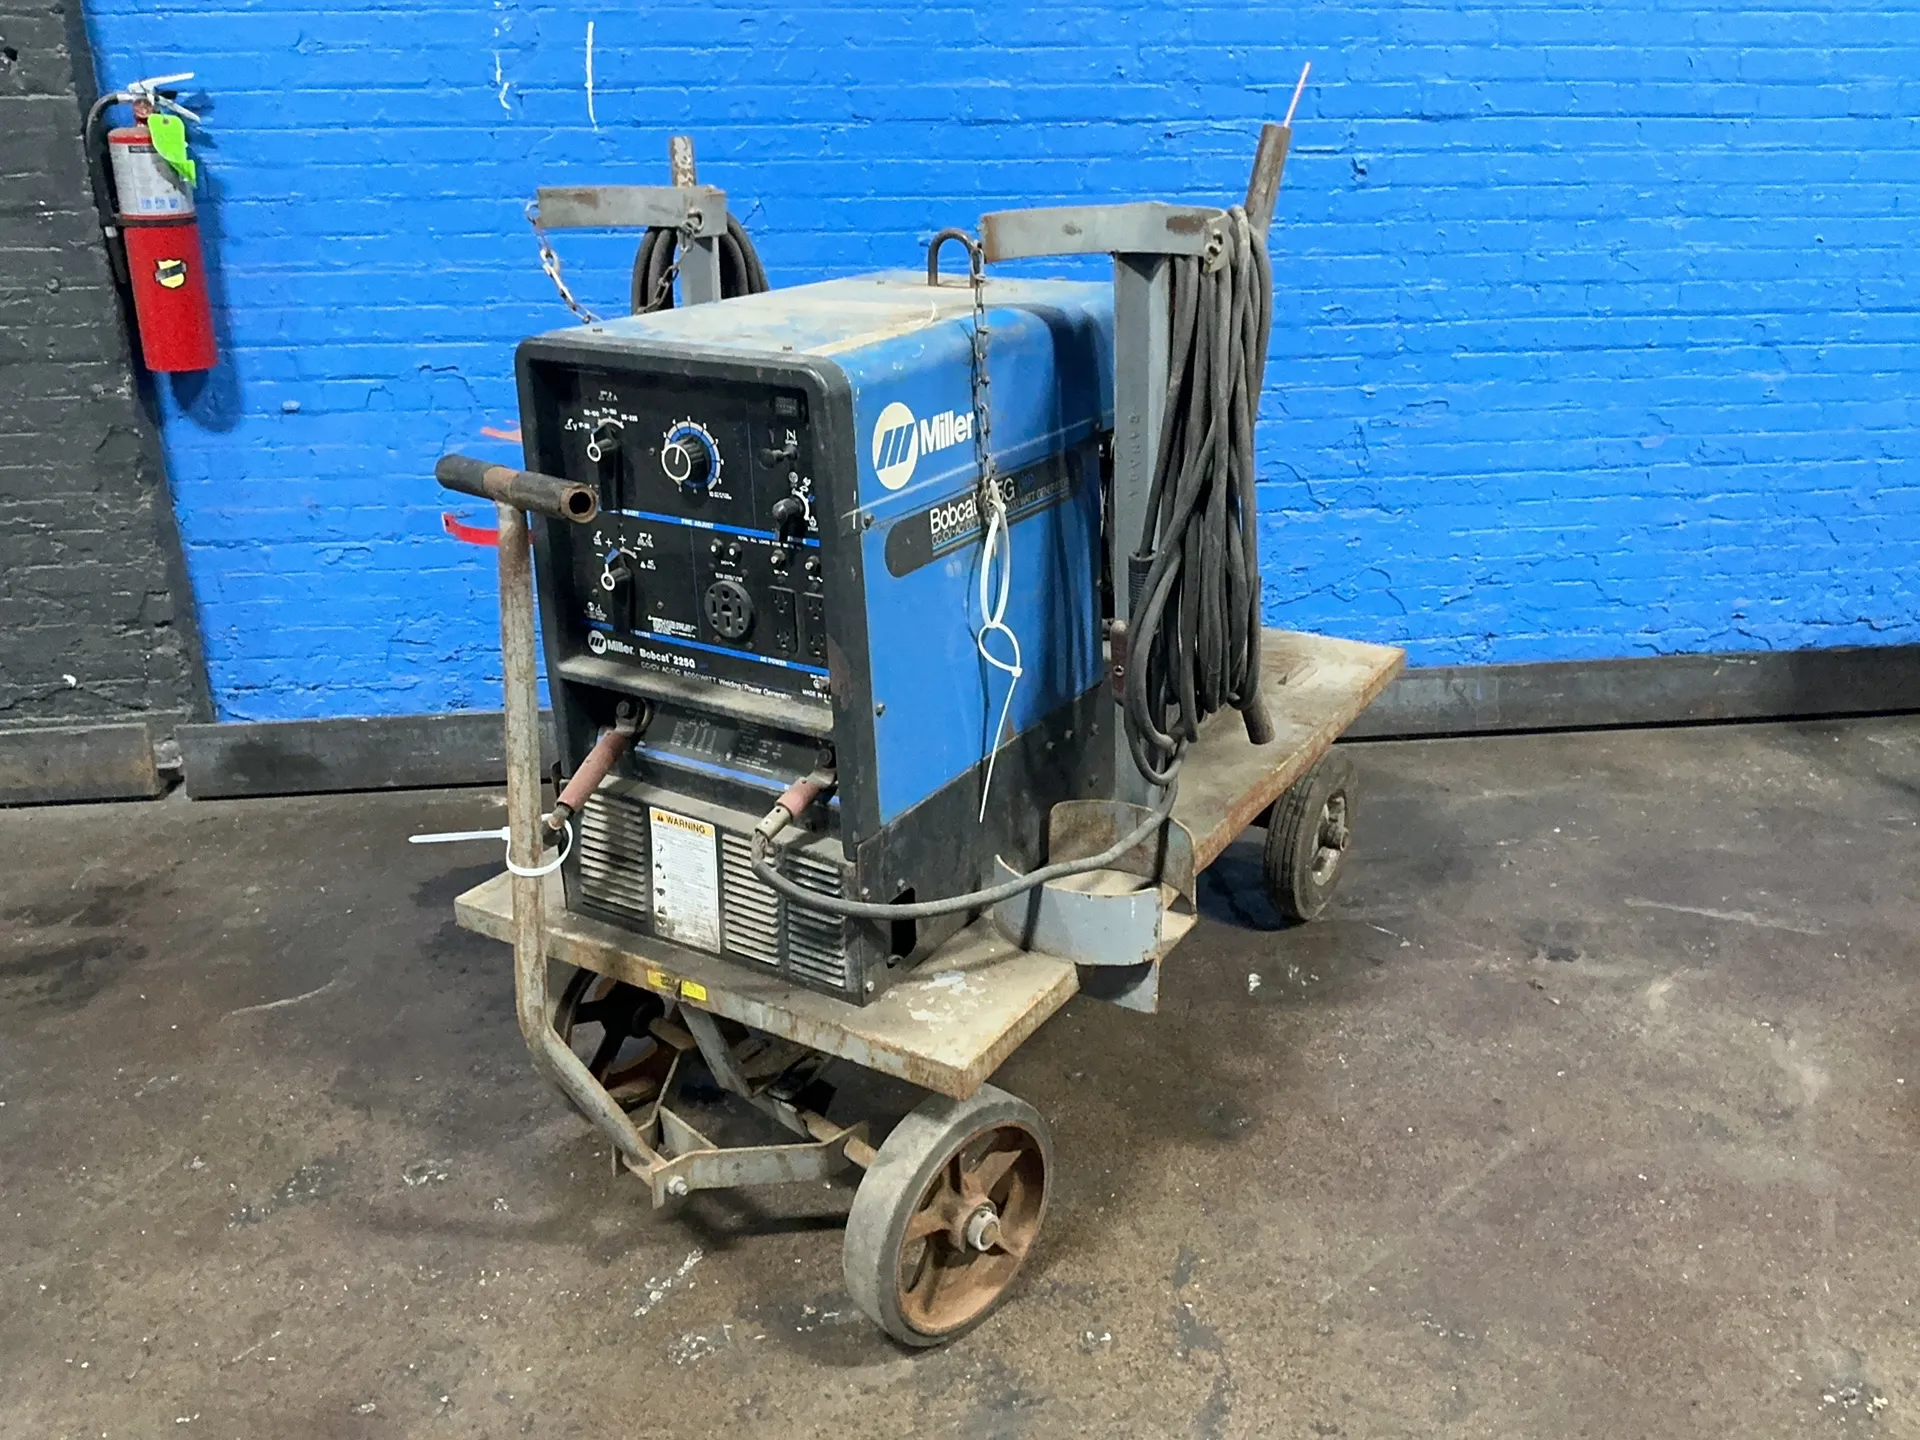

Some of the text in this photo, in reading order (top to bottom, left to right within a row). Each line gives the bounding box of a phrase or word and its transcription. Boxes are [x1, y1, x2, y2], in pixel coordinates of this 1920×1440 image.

[920, 410, 974, 456] Miller
[930, 492, 979, 534] Bobcat
[607, 639, 633, 655] Miller
[666, 815, 706, 834] WARNING
